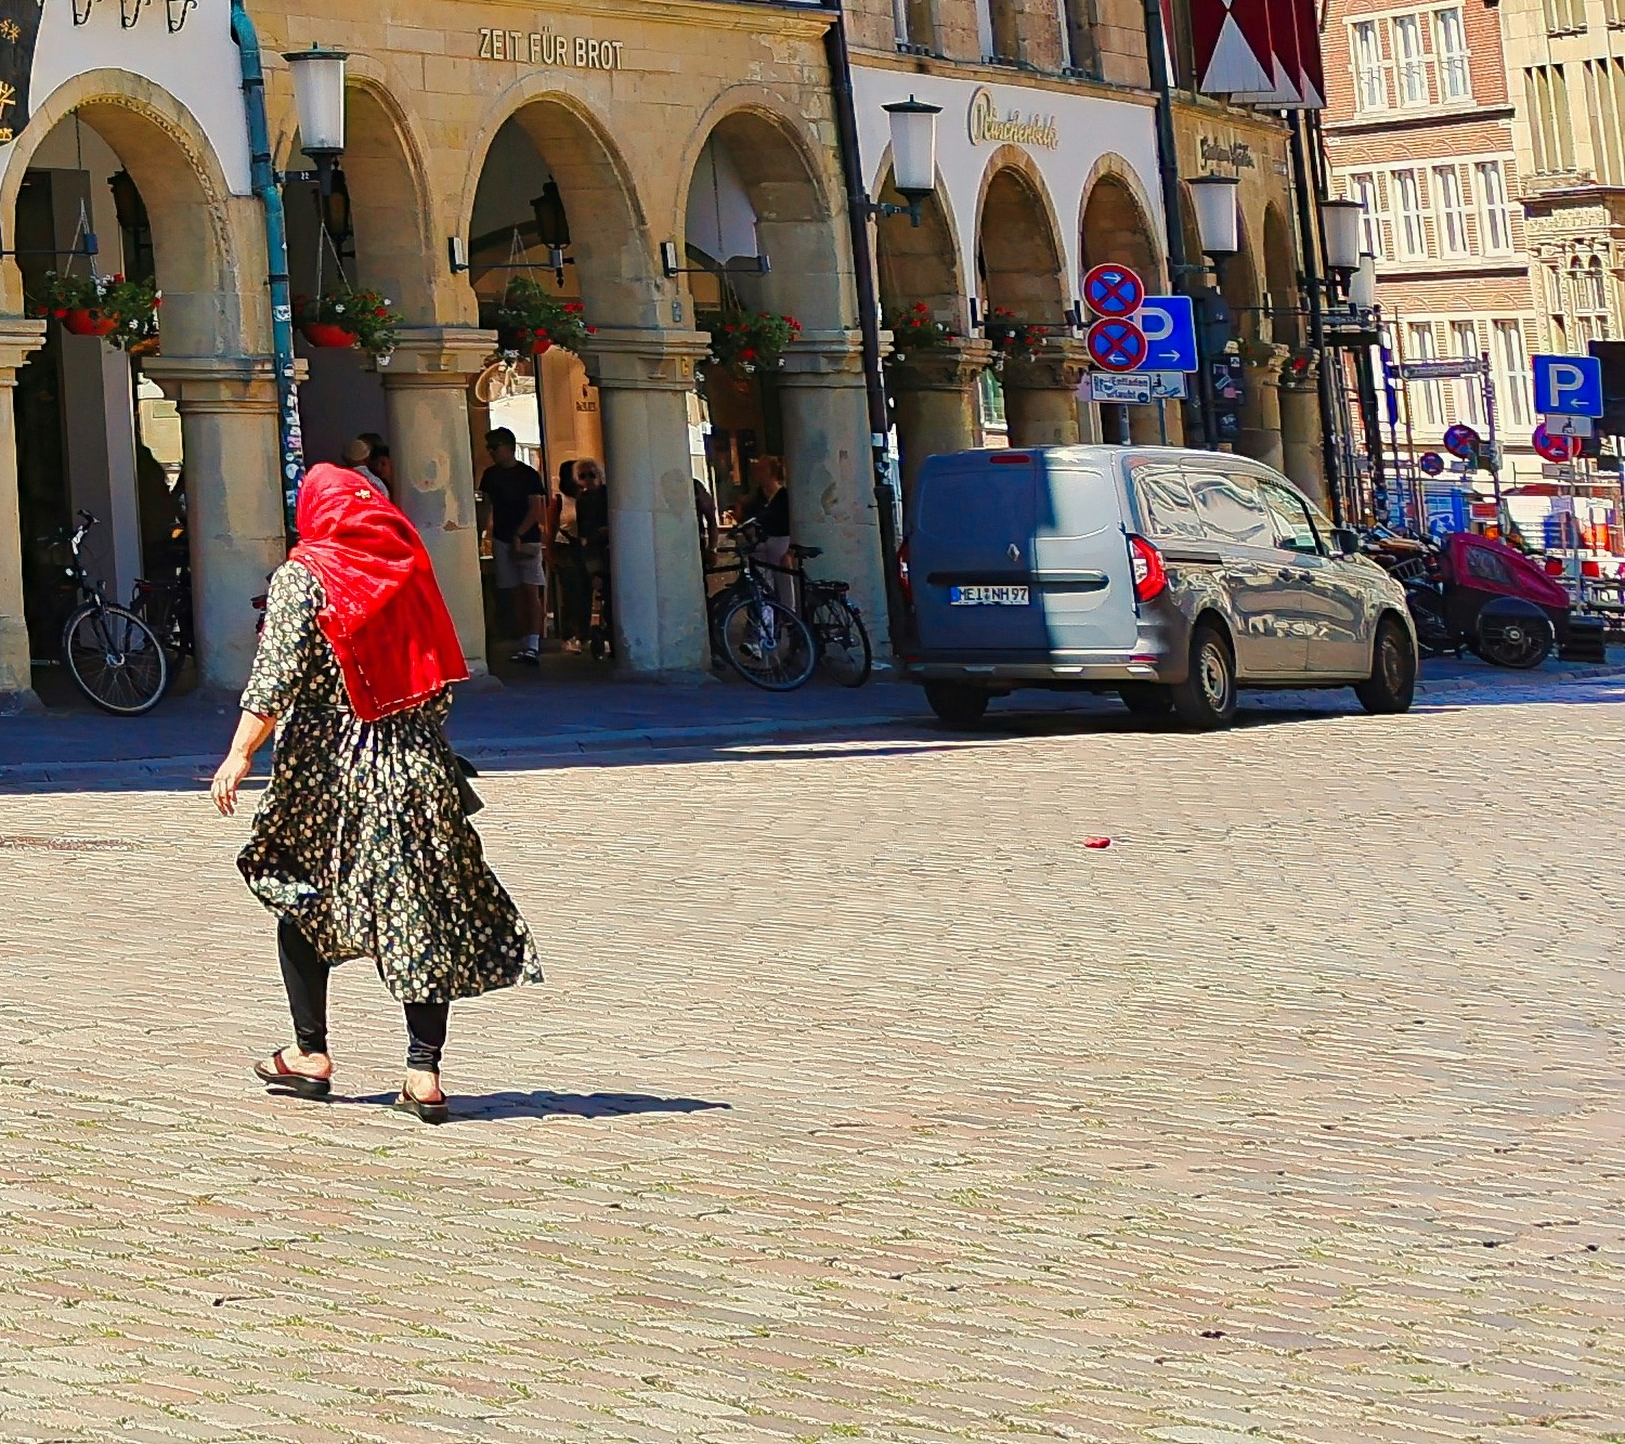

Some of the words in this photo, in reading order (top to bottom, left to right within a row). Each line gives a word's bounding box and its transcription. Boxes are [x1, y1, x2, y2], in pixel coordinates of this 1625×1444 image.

[478, 27, 523, 61] ZEIT
[530, 25, 569, 66] FÜR
[575, 37, 625, 71] BROT
[1132, 307, 1174, 341] P
[1548, 363, 1585, 407] P
[1011, 587, 1028, 601] 97
